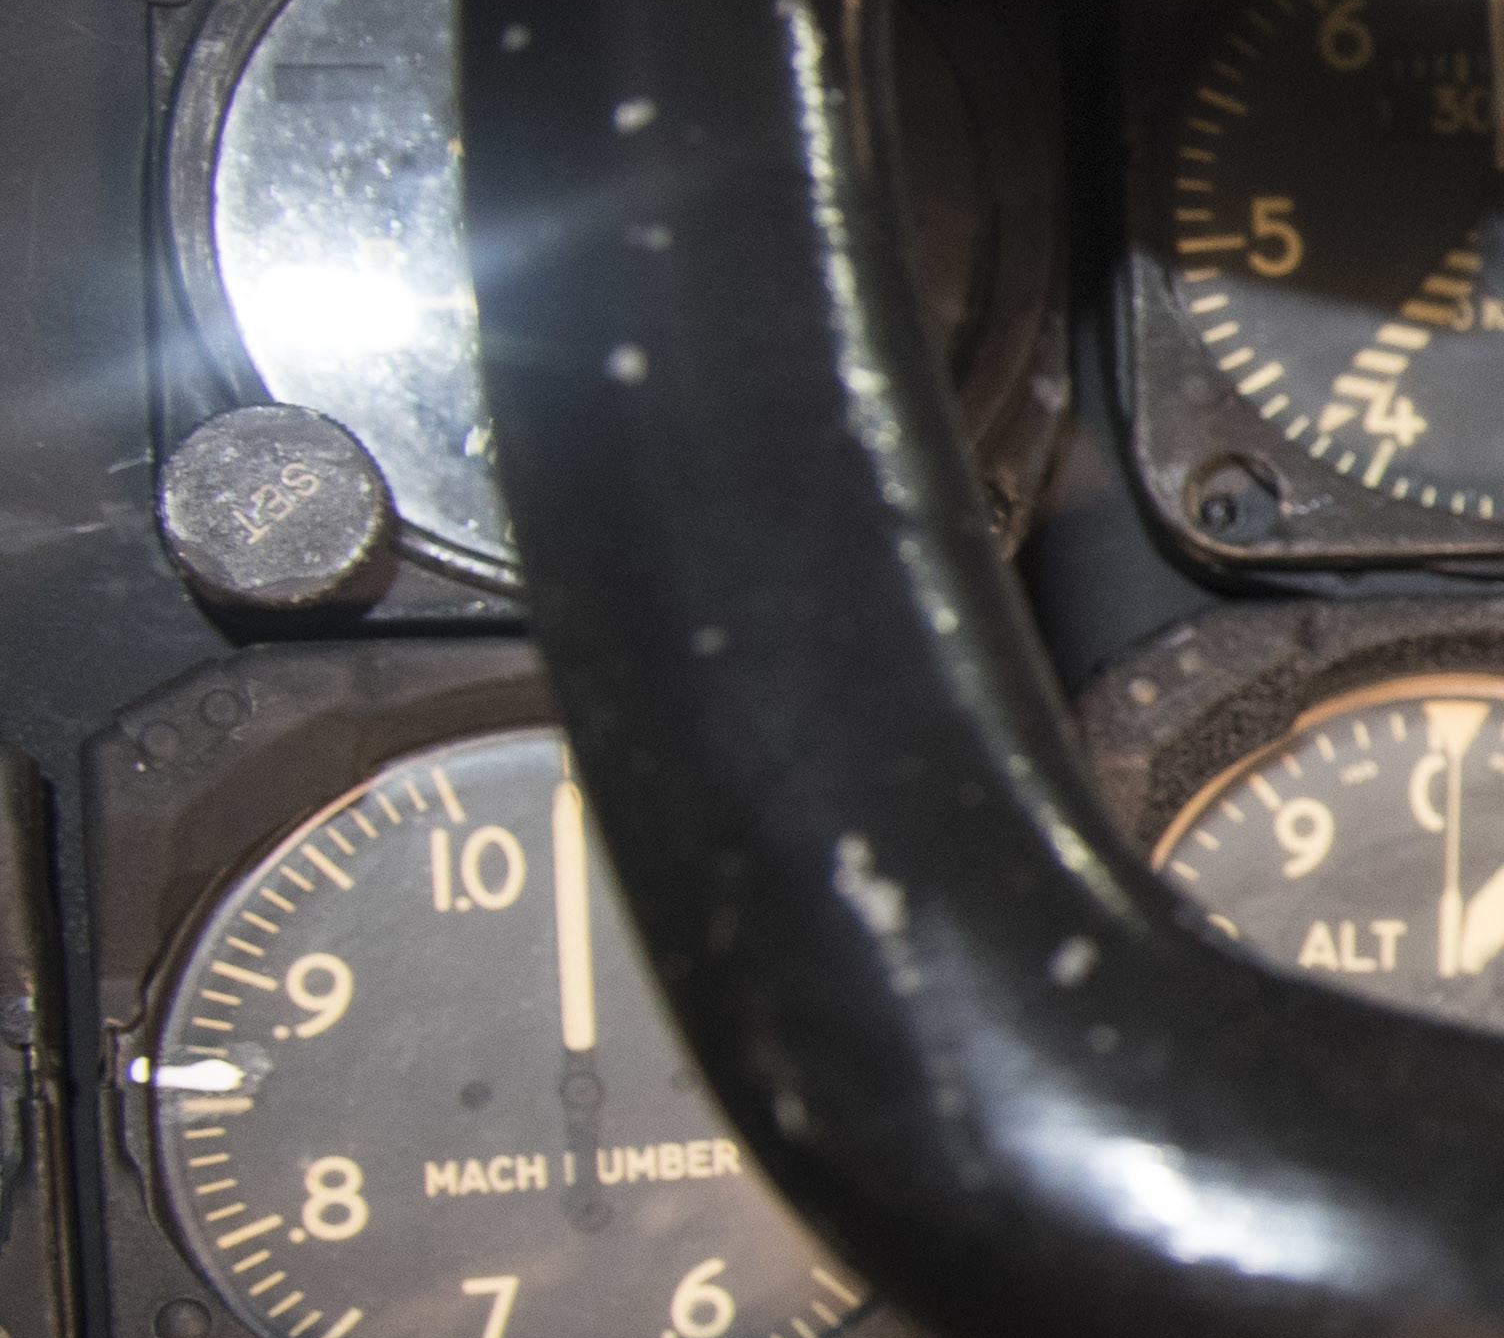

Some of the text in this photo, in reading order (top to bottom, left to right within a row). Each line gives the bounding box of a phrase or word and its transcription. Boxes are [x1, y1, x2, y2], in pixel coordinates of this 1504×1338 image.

[1246, 196, 1303, 278] 5
[429, 825, 529, 914] 1.0
[1273, 796, 1335, 879] 9
[1296, 918, 1407, 974] ALT
[424, 1139, 743, 1199] MACH UMBER
